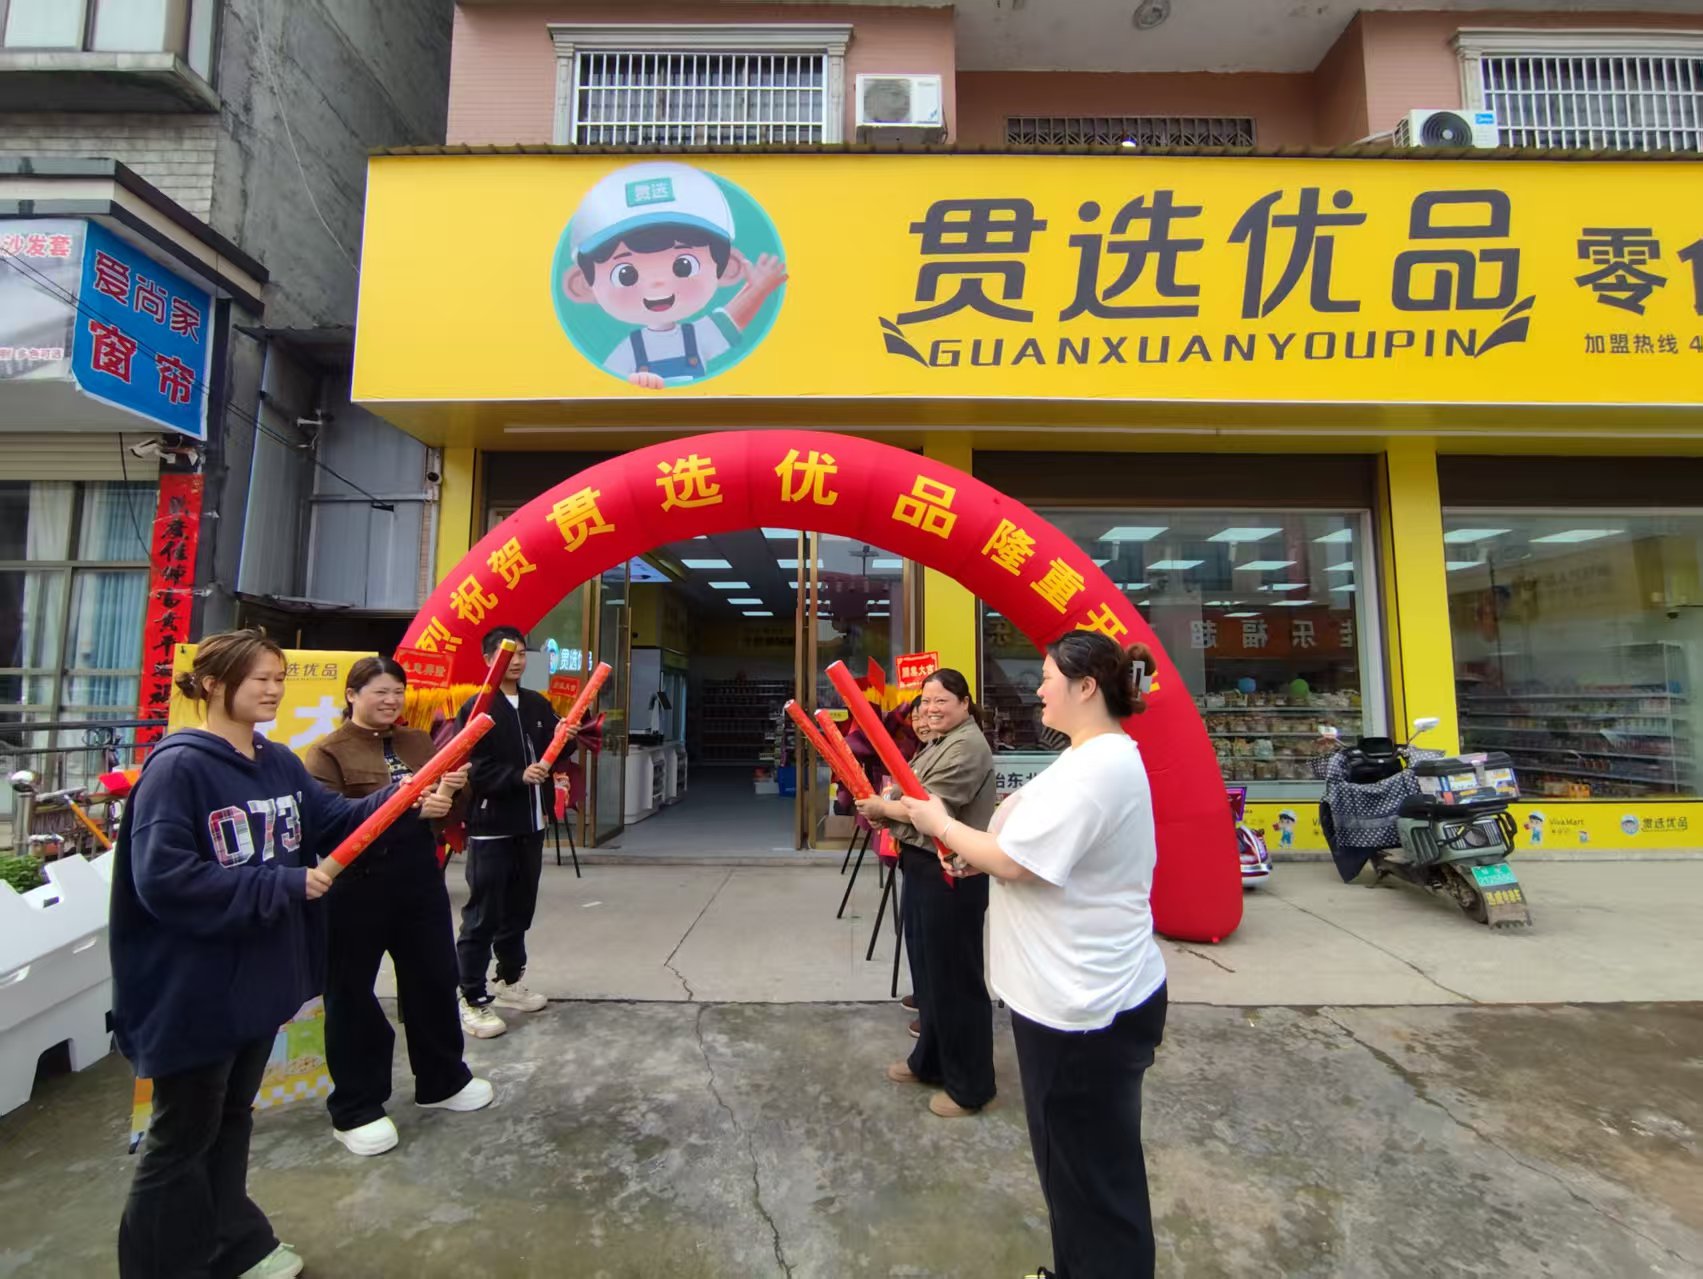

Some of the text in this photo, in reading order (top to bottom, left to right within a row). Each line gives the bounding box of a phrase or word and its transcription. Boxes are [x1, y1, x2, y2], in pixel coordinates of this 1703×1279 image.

[94, 249, 201, 344] 爱尚家
[896, 187, 1521, 326] 贯选优品
[1574, 227, 1703, 317] 零
[87, 319, 195, 405] 窗帘
[928, 328, 1479, 367] GUANXUANYOUPIN
[1584, 333, 1679, 354] 加盟热线
